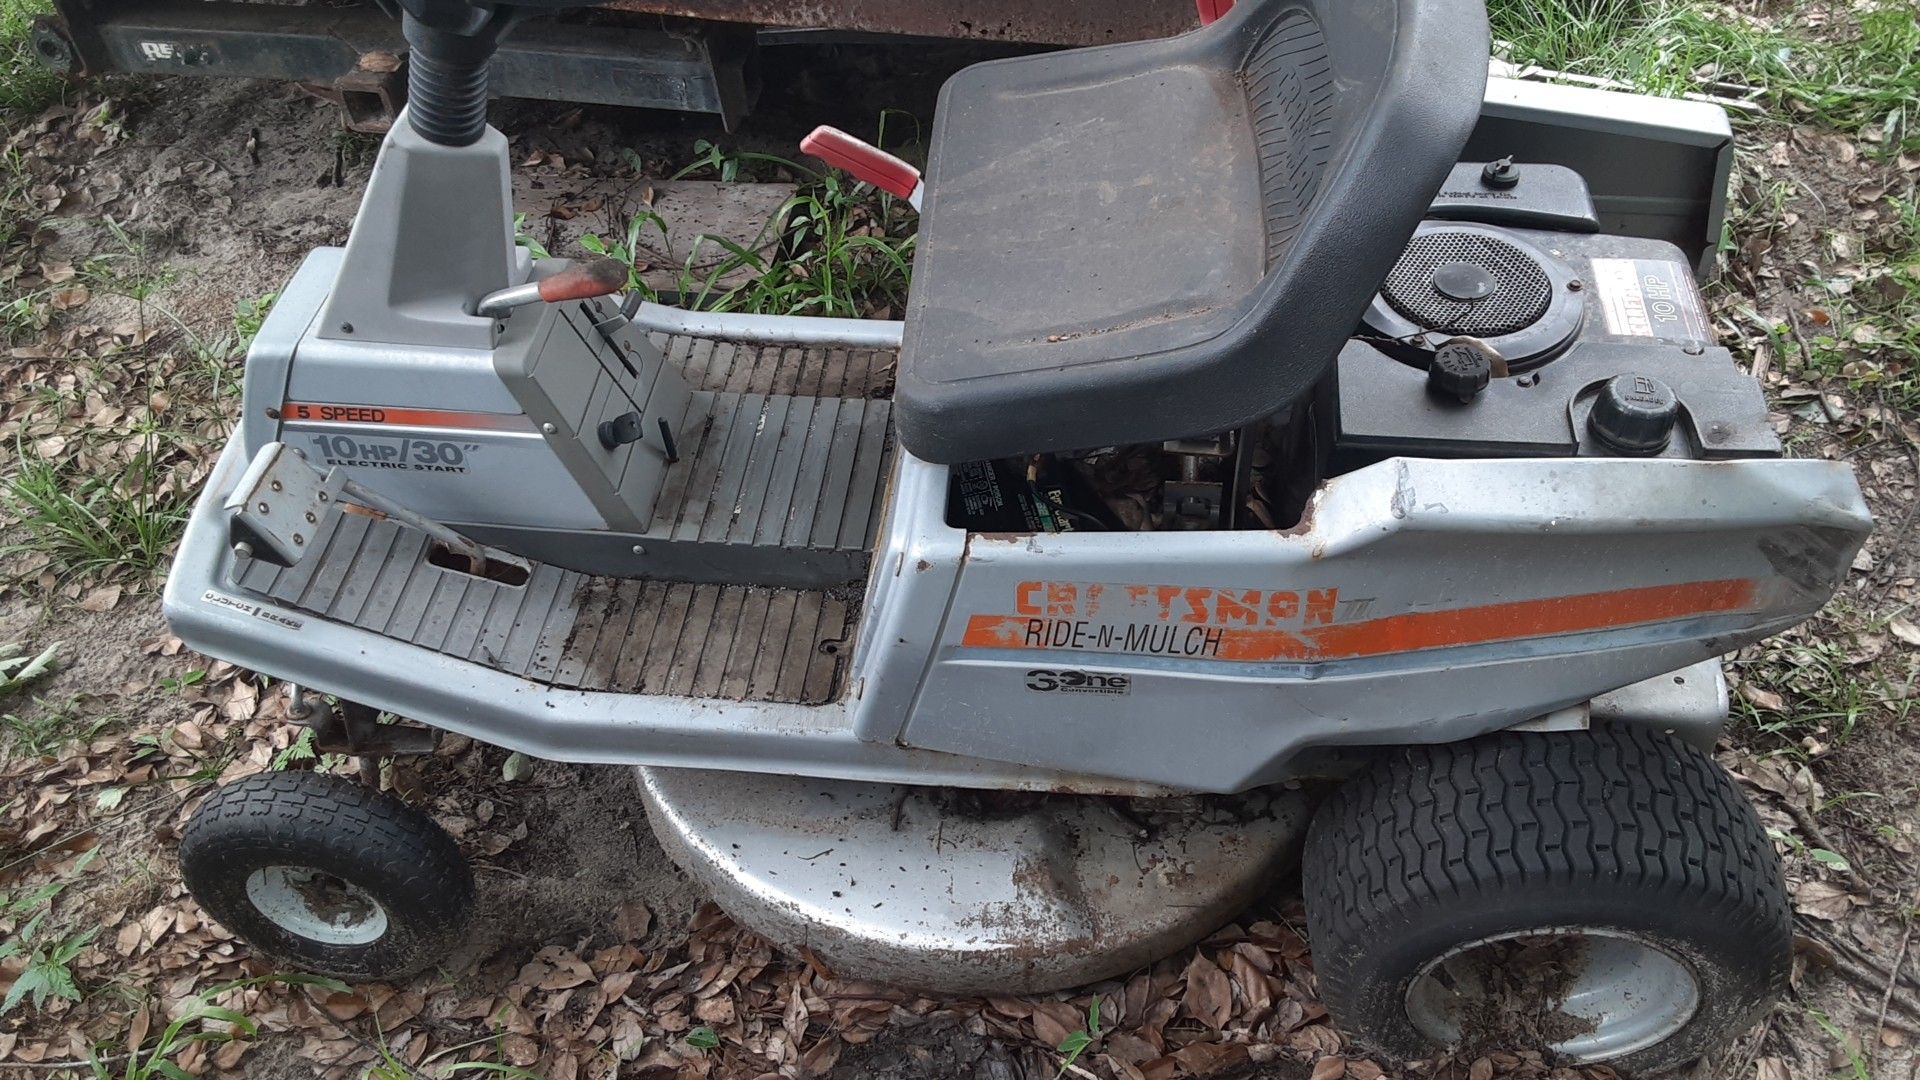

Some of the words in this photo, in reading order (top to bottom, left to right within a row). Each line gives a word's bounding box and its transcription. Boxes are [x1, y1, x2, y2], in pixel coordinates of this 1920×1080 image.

[1643, 274, 1672, 300] HP
[1651, 300, 1678, 323] 10
[297, 405, 310, 420] 5
[321, 407, 386, 423] SPEED
[312, 434, 480, 467] 10HP/30"
[326, 458, 408, 471] ELECTRIC
[413, 463, 466, 474] START
[205, 592, 253, 613] CLUTCH
[261, 611, 303, 629] BRAKE
[1024, 618, 1223, 657] RIDE-N-MULCH
[1060, 686, 1126, 696] Convertible
